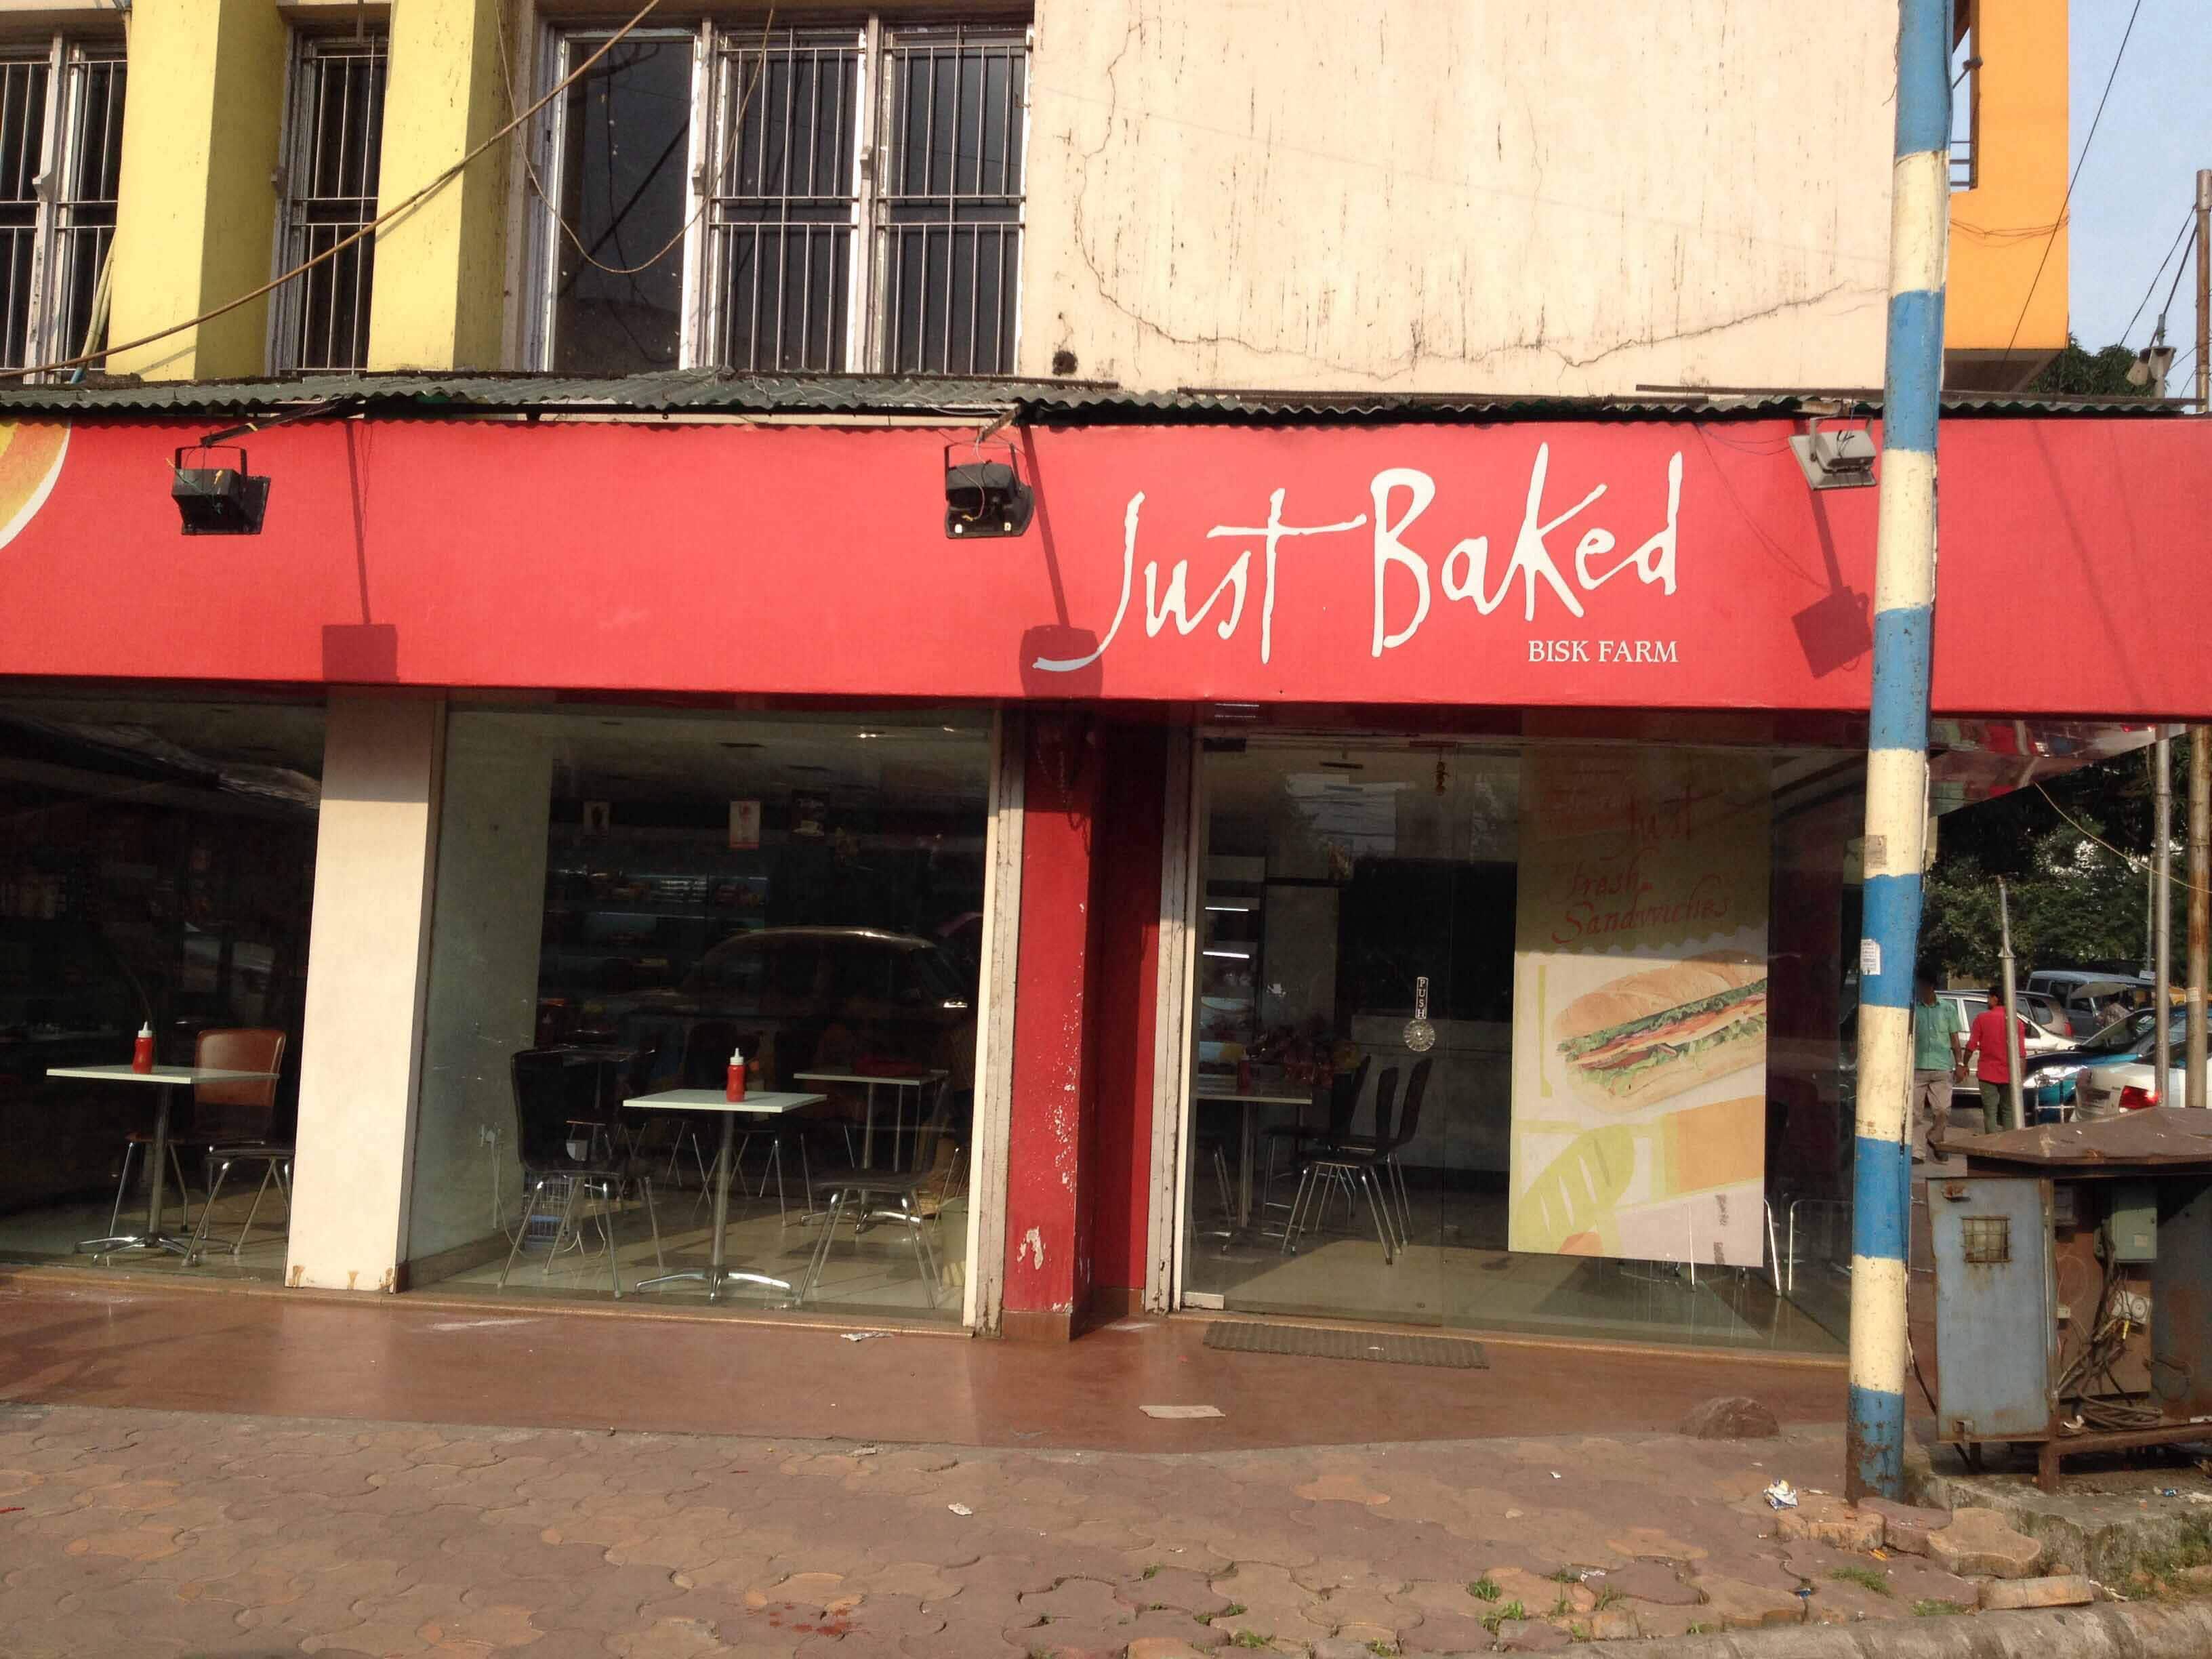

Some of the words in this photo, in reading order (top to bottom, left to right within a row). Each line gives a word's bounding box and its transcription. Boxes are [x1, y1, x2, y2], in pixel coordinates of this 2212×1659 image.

[1033, 487, 1368, 672] Just
[1370, 442, 1683, 658] Baked
[1528, 640, 1590, 662] BISK
[1598, 640, 1679, 663] FARM
[1551, 874, 1732, 943] Sandwiches
[1417, 979, 1426, 1017] PUSH
